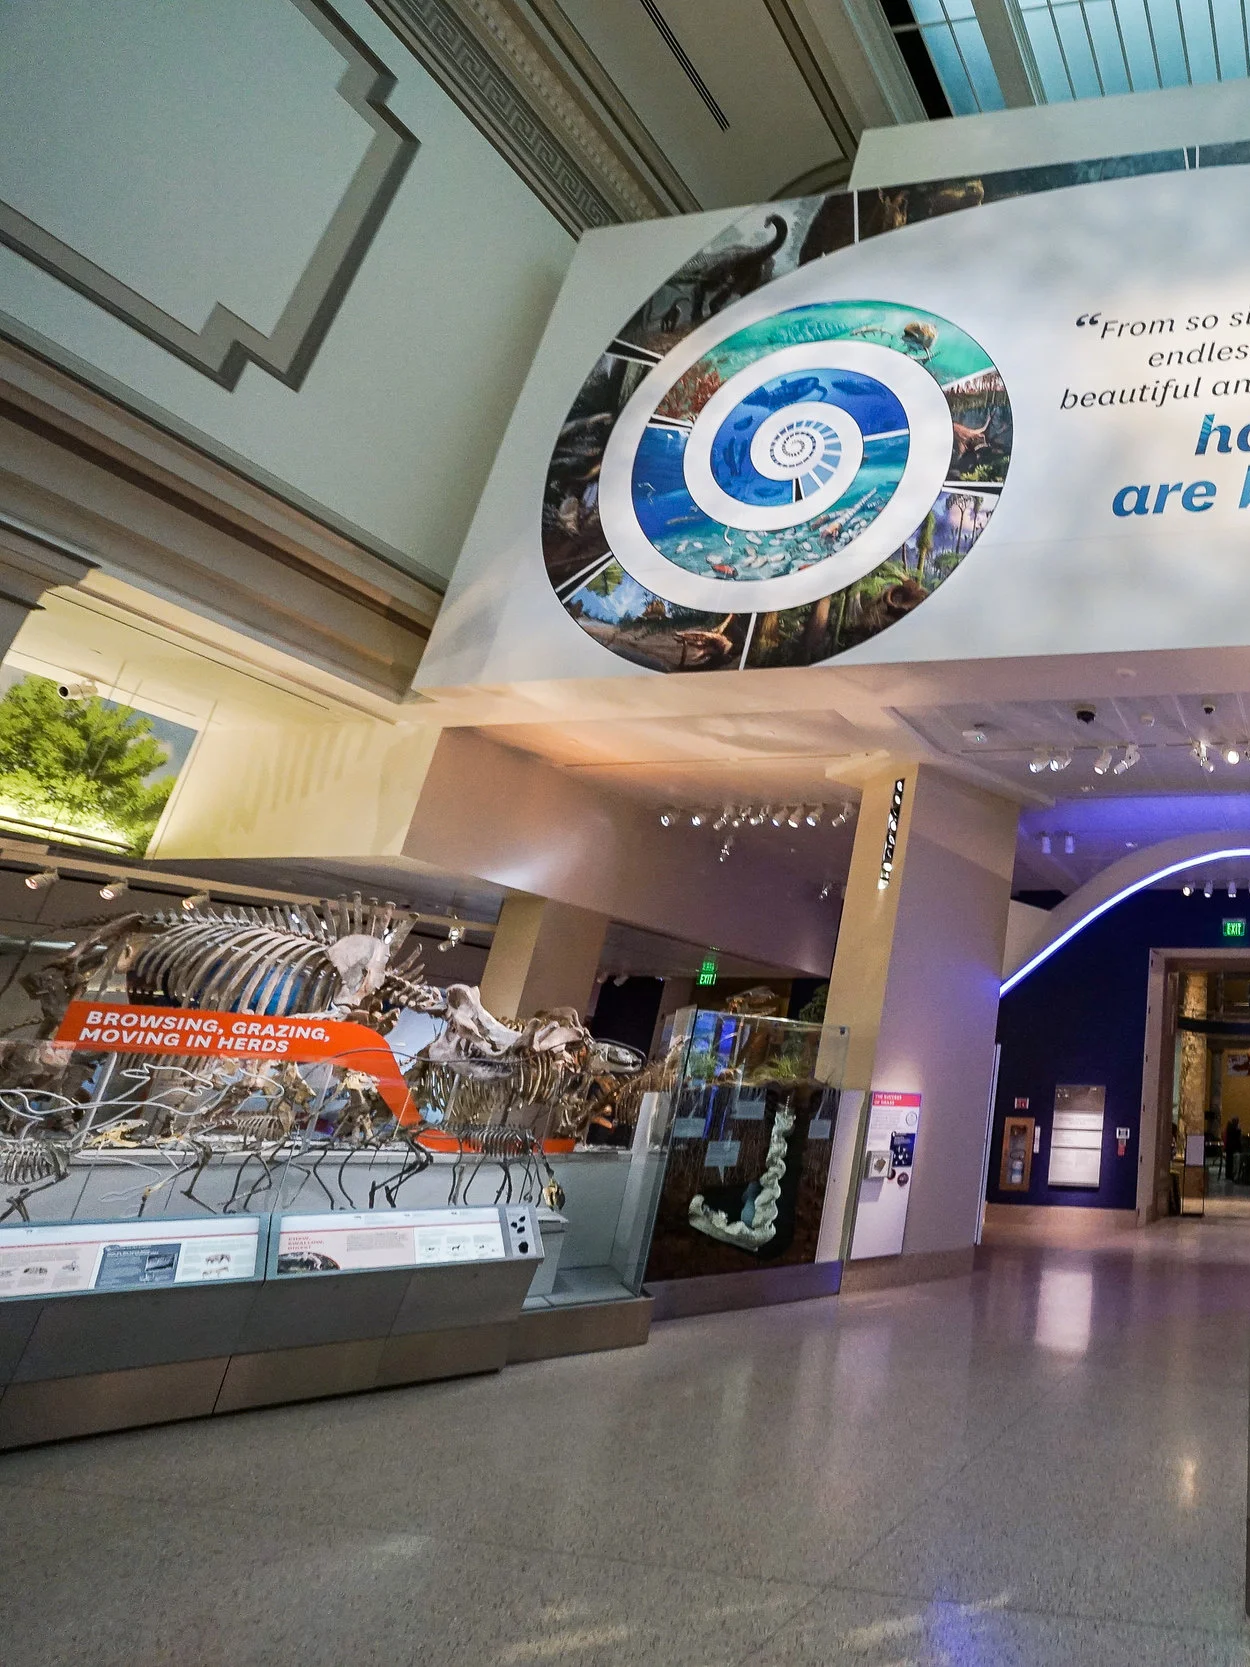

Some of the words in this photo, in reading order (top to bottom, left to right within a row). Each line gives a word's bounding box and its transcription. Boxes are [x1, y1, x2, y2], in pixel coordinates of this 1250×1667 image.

[1076, 312, 1175, 339] “From
[1186, 313, 1219, 332] so
[1060, 377, 1202, 410] beautiful
[1112, 482, 1217, 517] are
[1226, 922, 1242, 935] EXIT
[79, 1027, 180, 1047] MOVING
[186, 1033, 213, 1048] IN
[217, 1036, 289, 1053] HERDS
[86, 1010, 224, 1036] BROWSING,
[231, 1020, 331, 1043] GRAZING,
